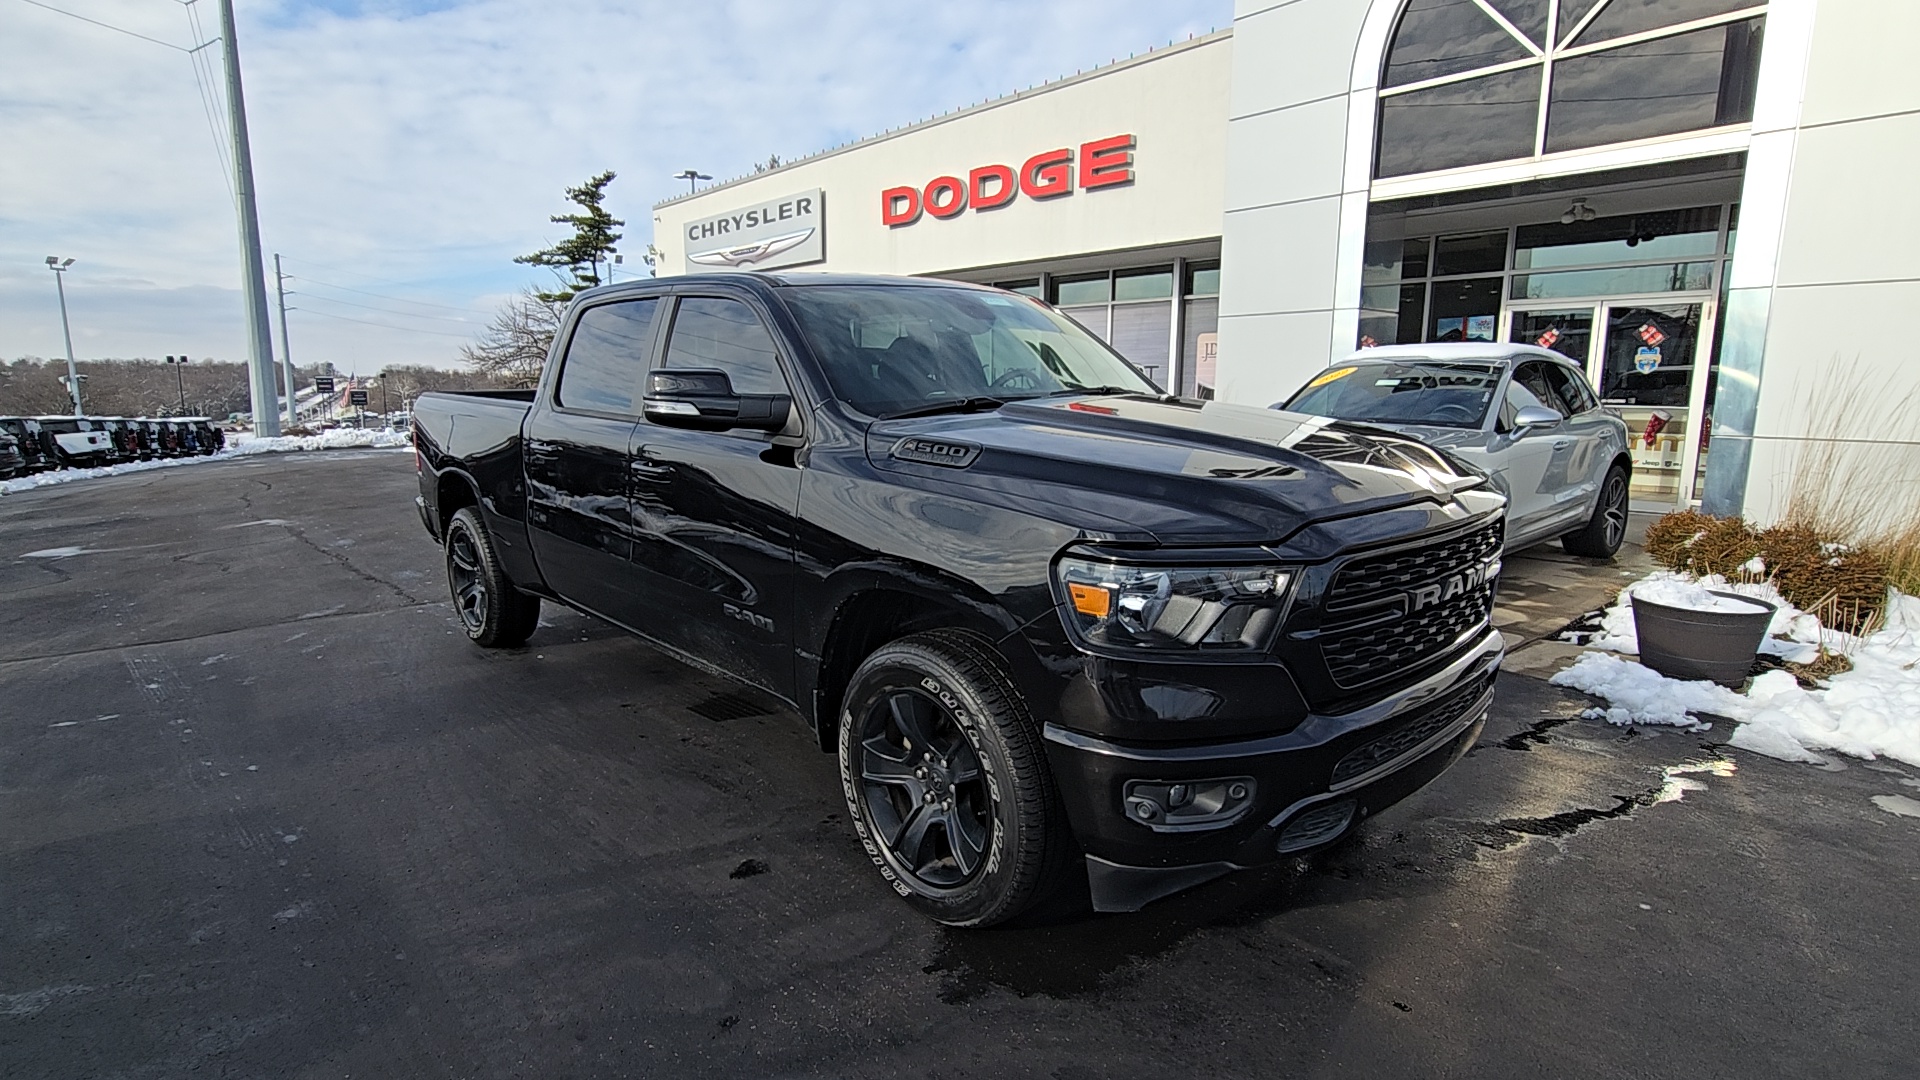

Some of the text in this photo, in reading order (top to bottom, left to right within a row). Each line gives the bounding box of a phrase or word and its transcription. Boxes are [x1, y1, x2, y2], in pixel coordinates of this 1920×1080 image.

[881, 133, 1136, 229] DODGE
[688, 197, 812, 241] CHRYSLER
[1414, 562, 1485, 611] RAM
